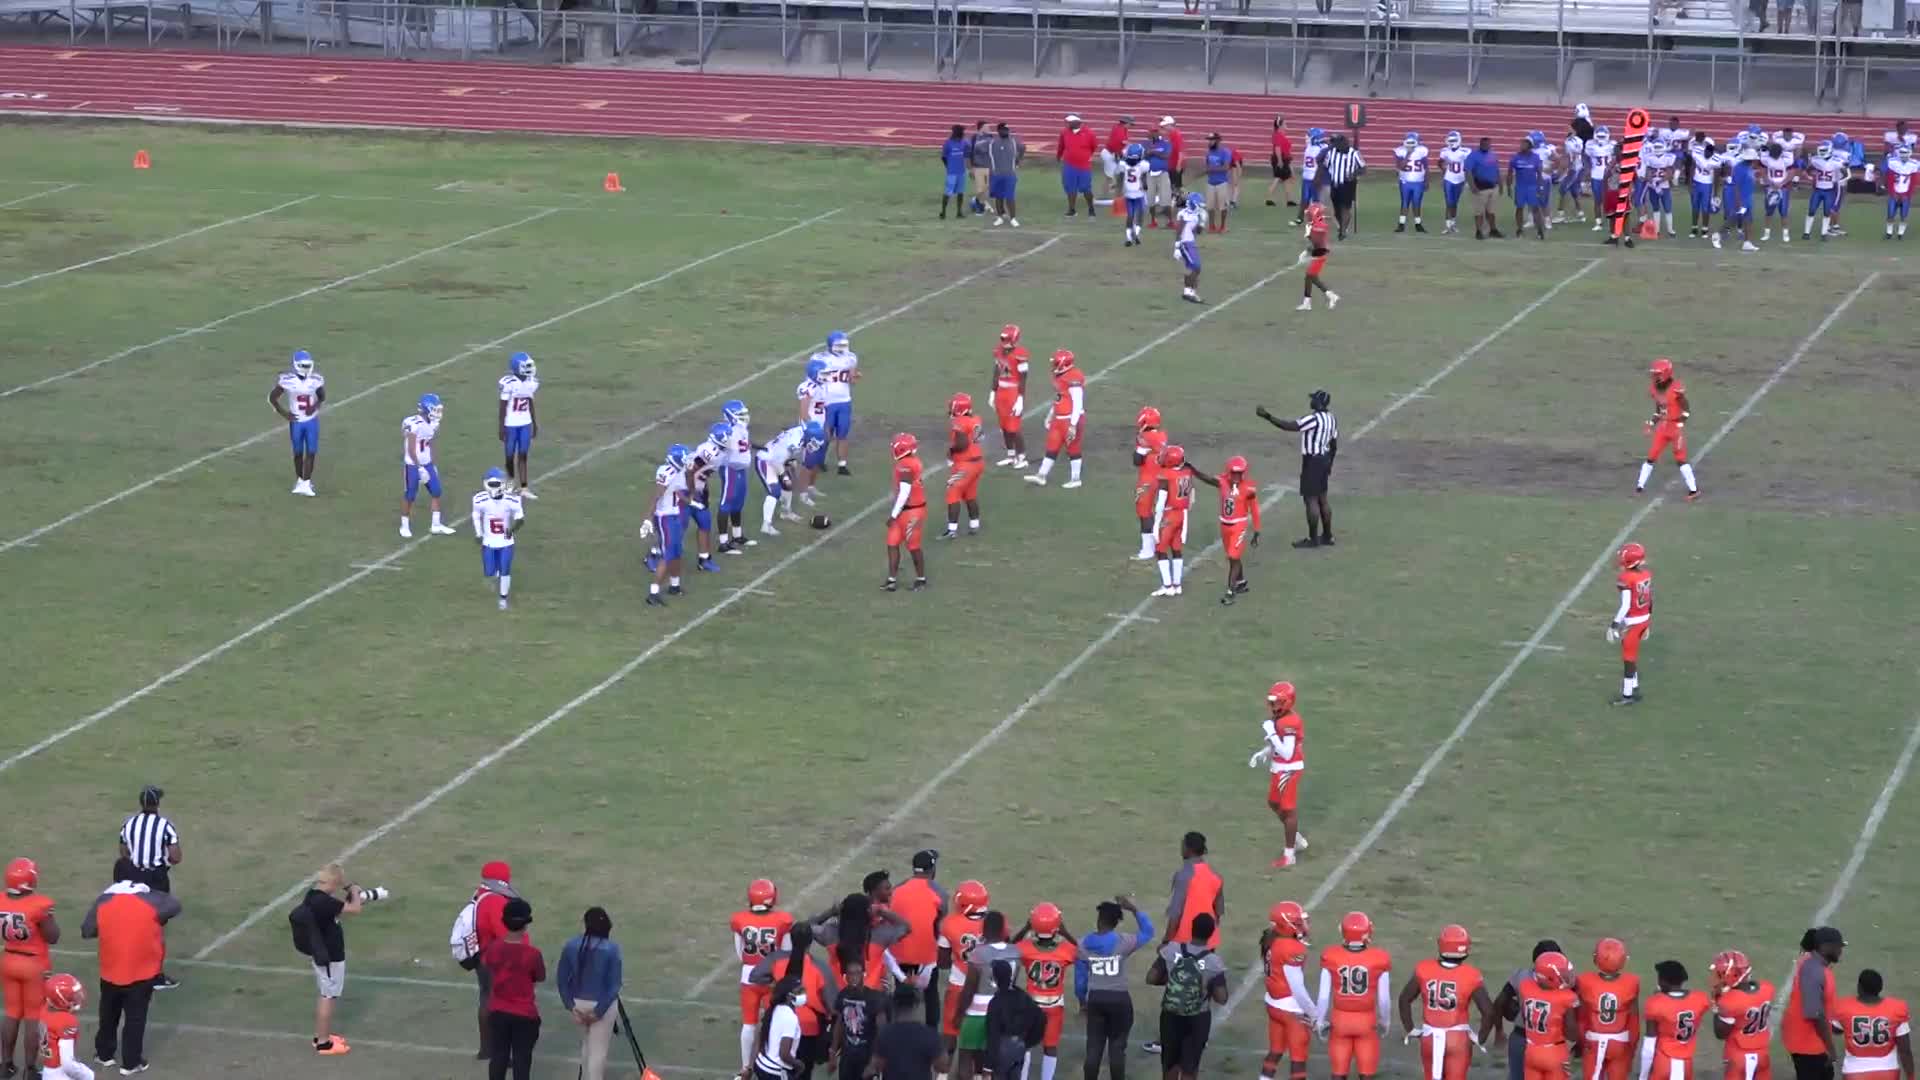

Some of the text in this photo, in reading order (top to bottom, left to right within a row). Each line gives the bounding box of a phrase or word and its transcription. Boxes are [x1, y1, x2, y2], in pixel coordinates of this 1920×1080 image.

[1126, 168, 1137, 183] 5
[513, 398, 529, 412] 12
[489, 518, 505, 535] 6
[742, 926, 777, 957] 95
[1027, 960, 1062, 989] 42
[1091, 962, 1119, 977] 20
[1338, 965, 1369, 996] 19
[1427, 979, 1457, 1012] 15
[1598, 993, 1618, 1025] 9
[1524, 998, 1551, 1034] 17
[1676, 1010, 1695, 1044] 5
[1851, 1015, 1890, 1047] 56
